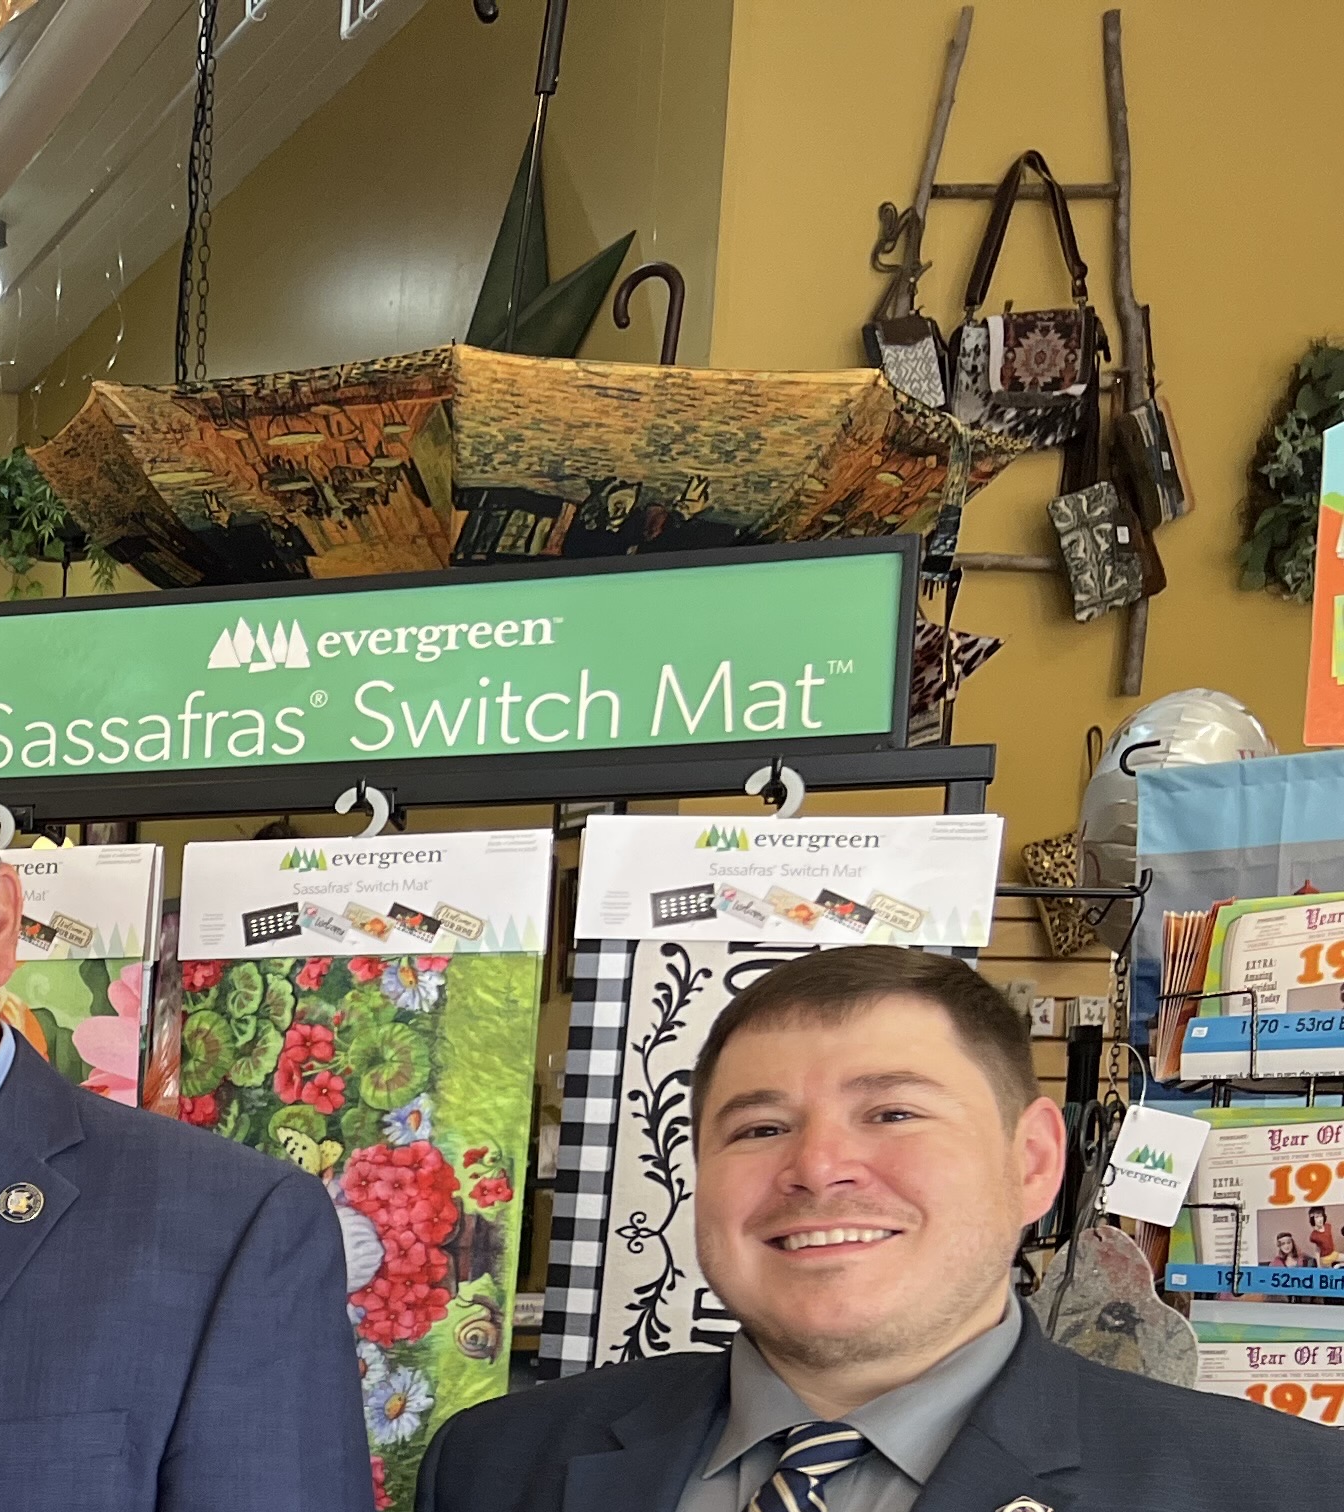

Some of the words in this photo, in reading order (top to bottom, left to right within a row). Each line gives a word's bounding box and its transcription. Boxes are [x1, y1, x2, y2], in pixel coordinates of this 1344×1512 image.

[349, 668, 620, 752] Switch
[754, 831, 879, 853] evergreen
[332, 848, 442, 870] evergreen
[781, 863, 830, 877] Switch
[356, 878, 399, 894] Switch
[1295, 1017, 1335, 1033] 53rd
[1268, 1128, 1309, 1151] Year
[1270, 1271, 1313, 1289] 52nd
[1246, 1346, 1287, 1369] Year
[1294, 1345, 1319, 1366] Of
